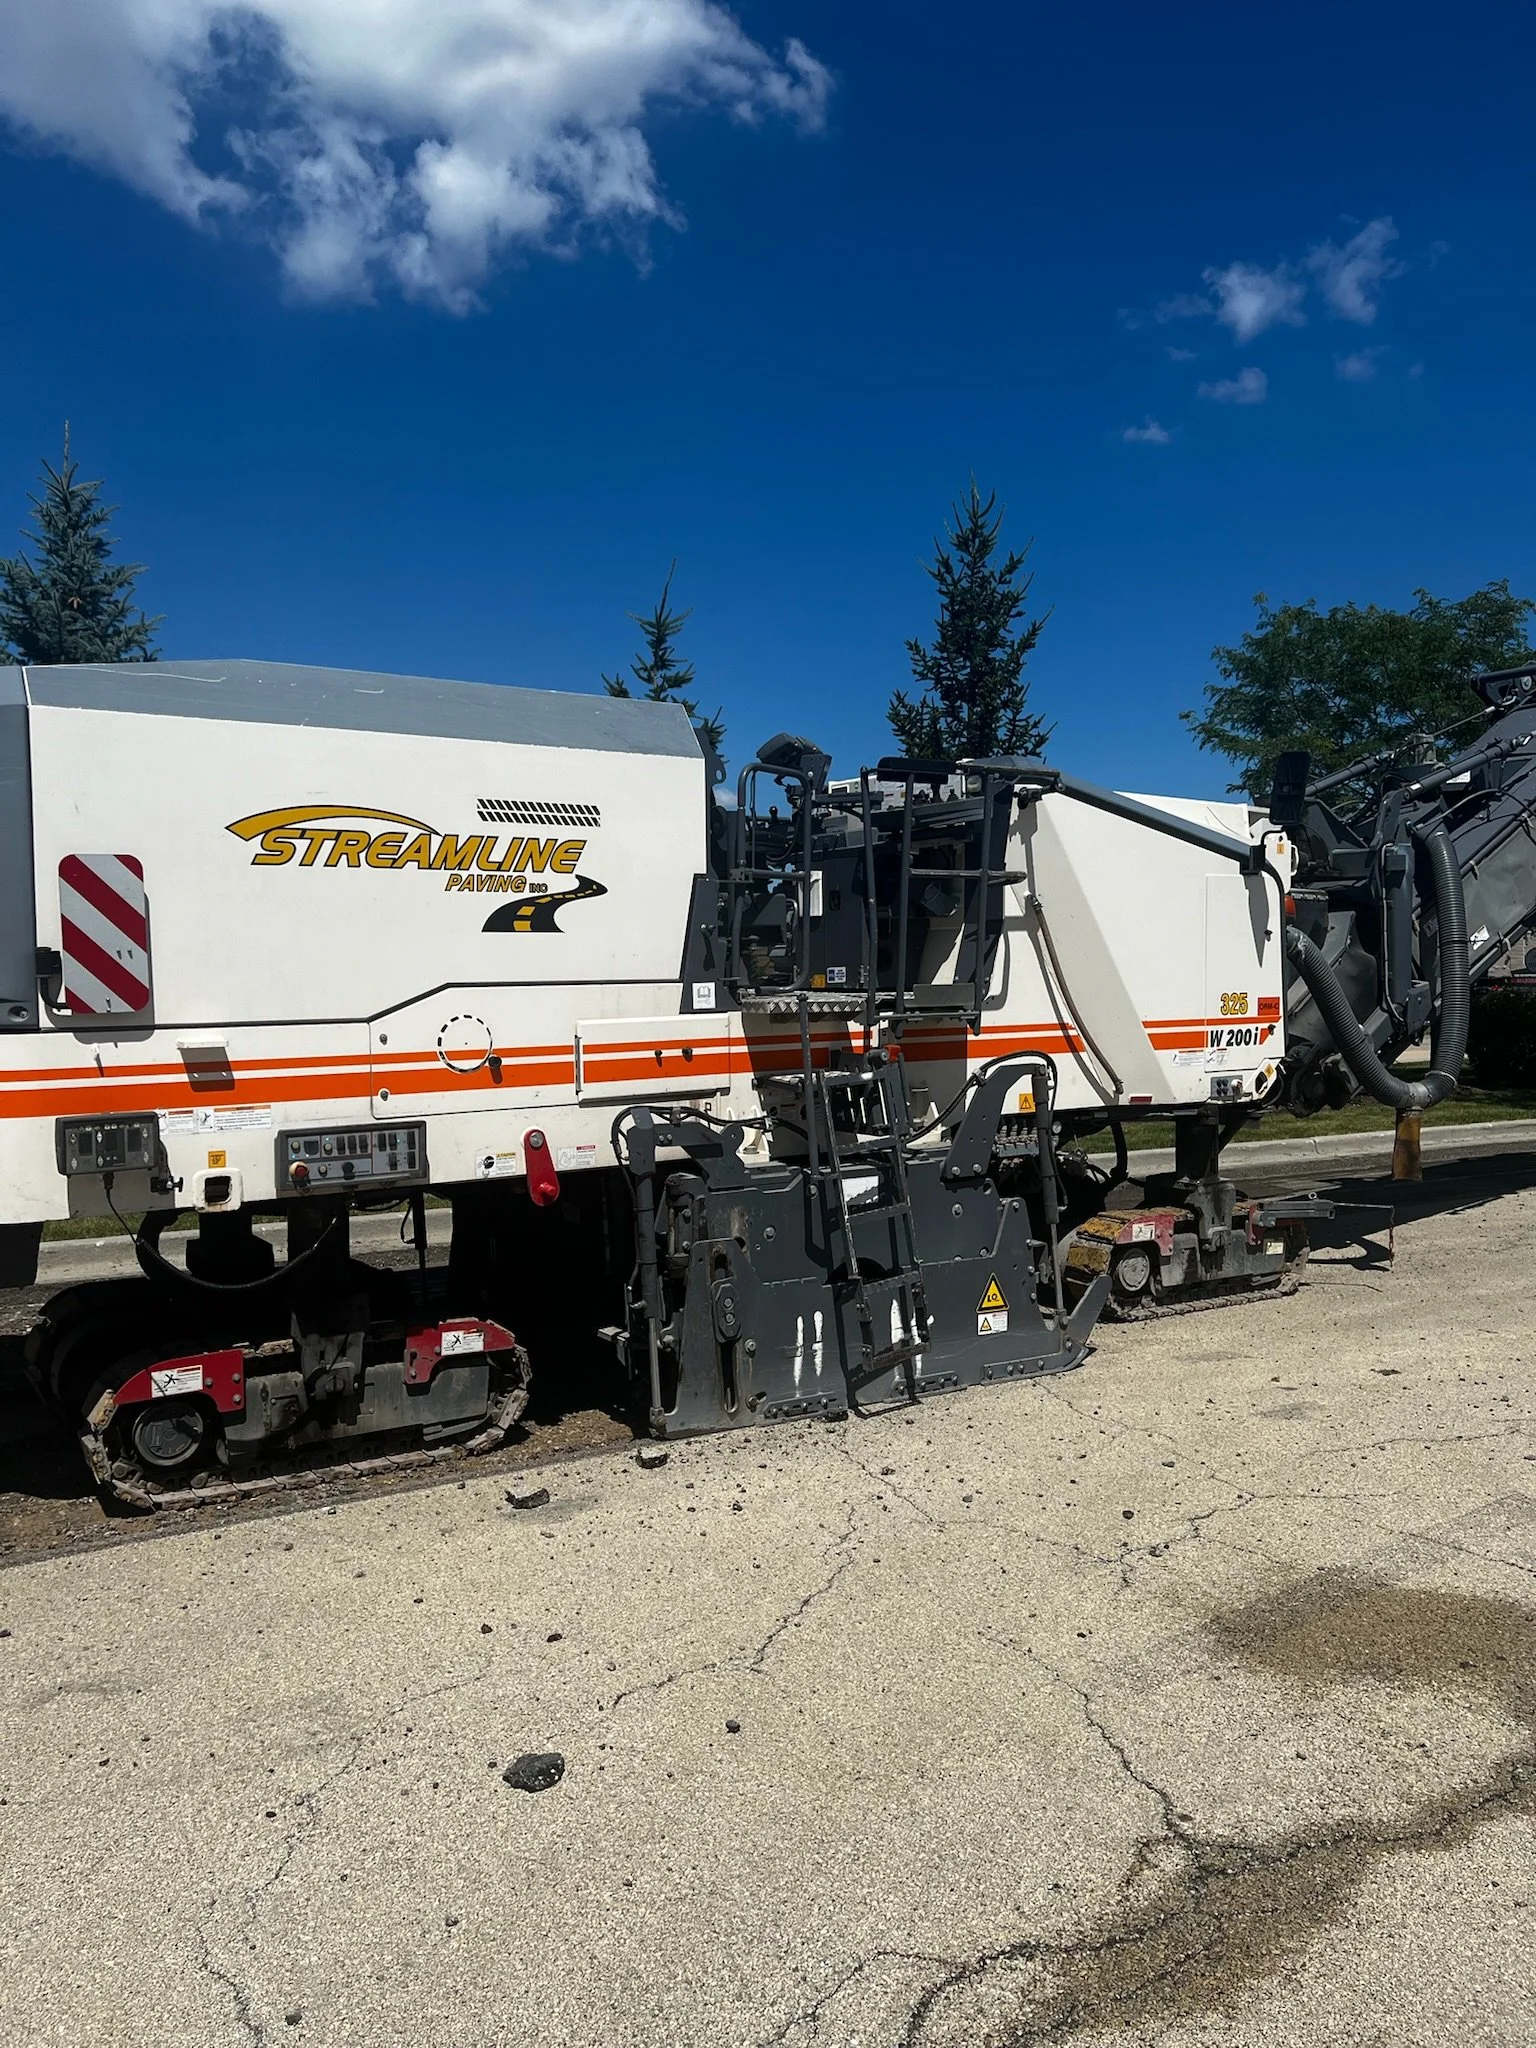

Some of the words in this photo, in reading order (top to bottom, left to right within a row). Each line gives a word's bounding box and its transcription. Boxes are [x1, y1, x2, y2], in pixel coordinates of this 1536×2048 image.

[251, 828, 588, 874] STREAMLINE
[445, 873, 528, 893] PAVING
[529, 883, 549, 893] INC
[1220, 992, 1249, 1016] 325
[1210, 1030, 1224, 1048] W
